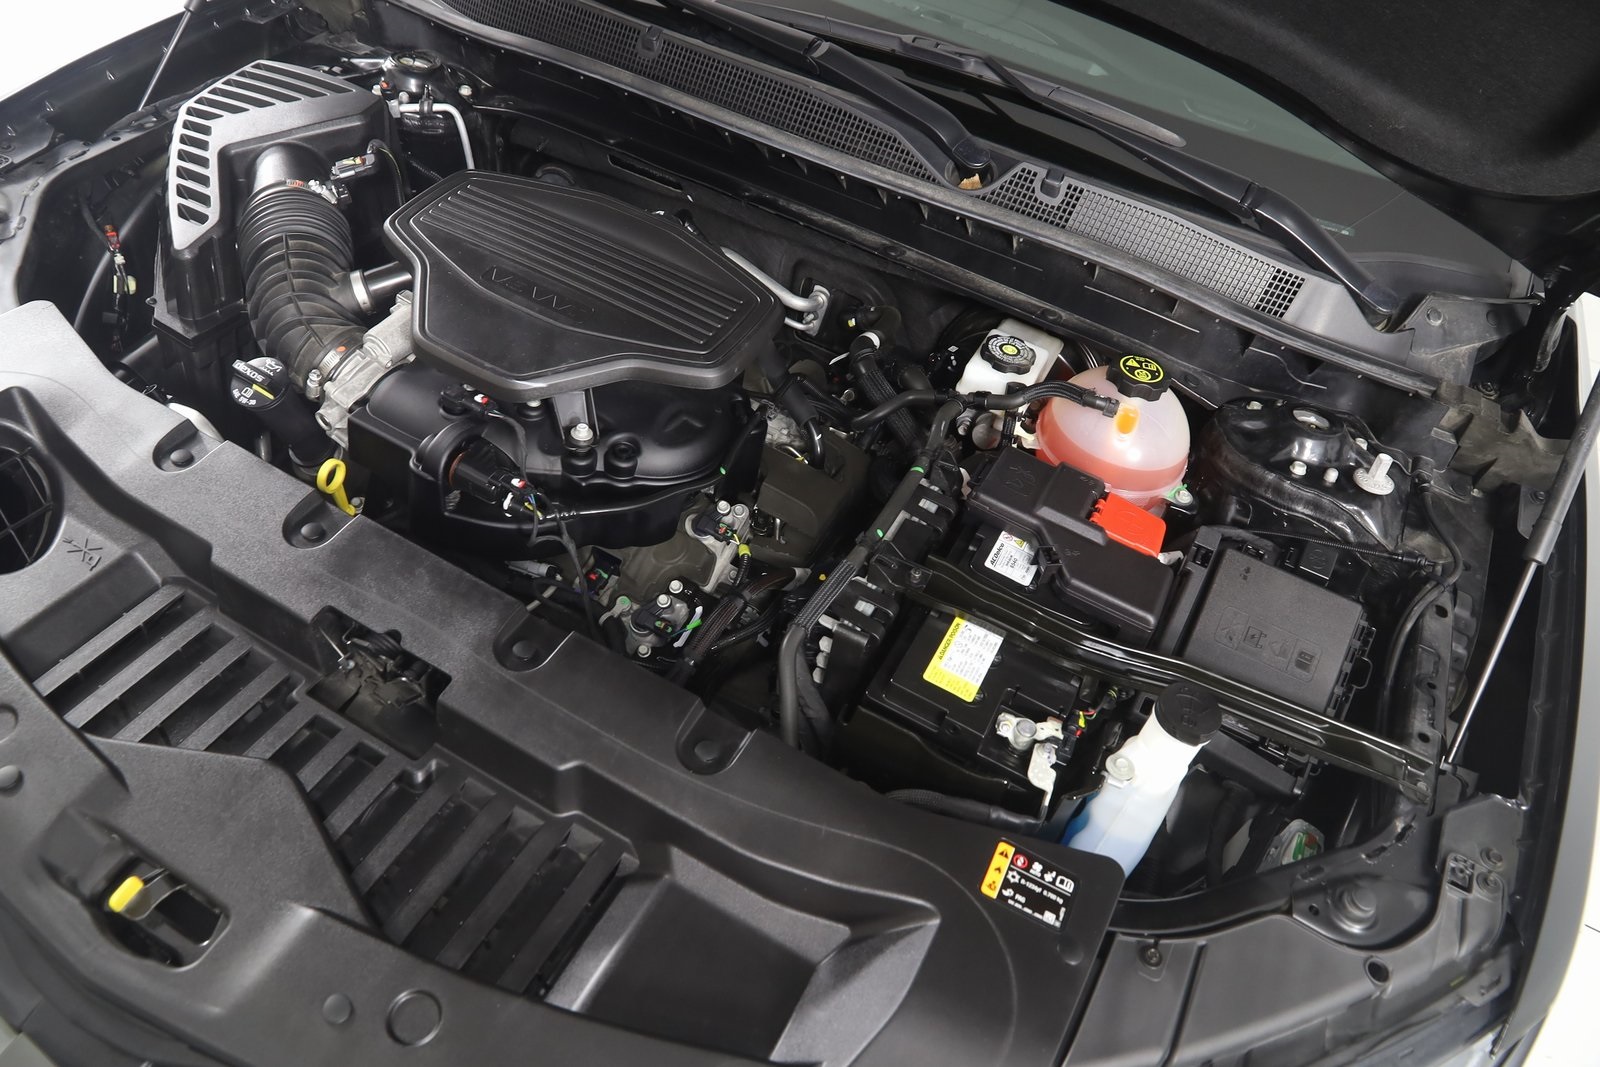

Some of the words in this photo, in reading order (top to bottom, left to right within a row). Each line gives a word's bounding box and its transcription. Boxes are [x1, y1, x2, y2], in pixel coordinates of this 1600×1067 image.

[235, 361, 266, 383] dexos
[990, 543, 1005, 566] ACDelco
[939, 637, 952, 656] DANGER
[948, 622, 961, 638] POISON
